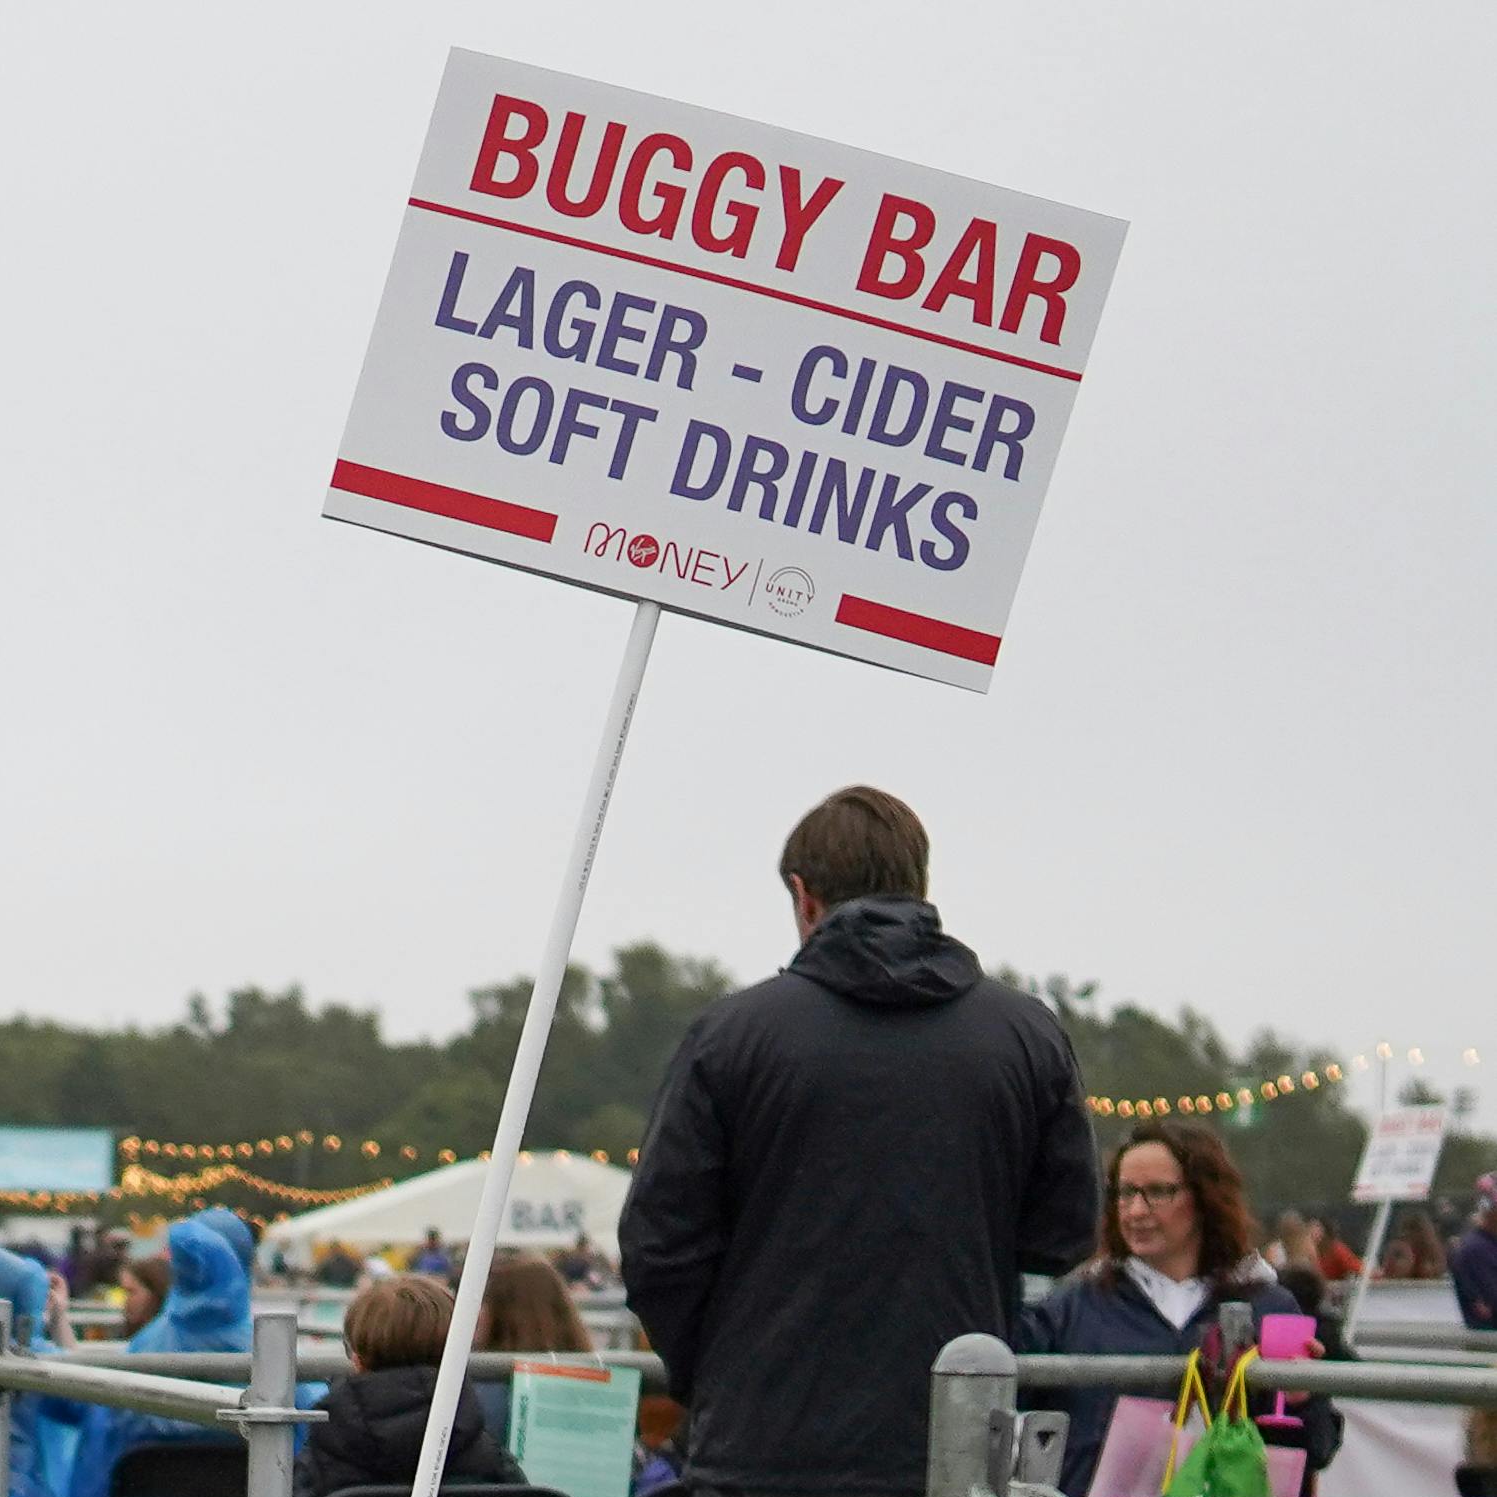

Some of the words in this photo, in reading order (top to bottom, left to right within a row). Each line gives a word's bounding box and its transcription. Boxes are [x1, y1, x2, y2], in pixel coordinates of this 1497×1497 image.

[469, 94, 845, 272] BUGGY
[855, 193, 1081, 346] BAR
[434, 251, 707, 391] LAGER
[790, 345, 1036, 482] CIDER
[440, 362, 659, 481] SOFT
[669, 419, 978, 572] DRINKS
[766, 582, 814, 604] UNITY
[510, 1199, 586, 1233] BAR
